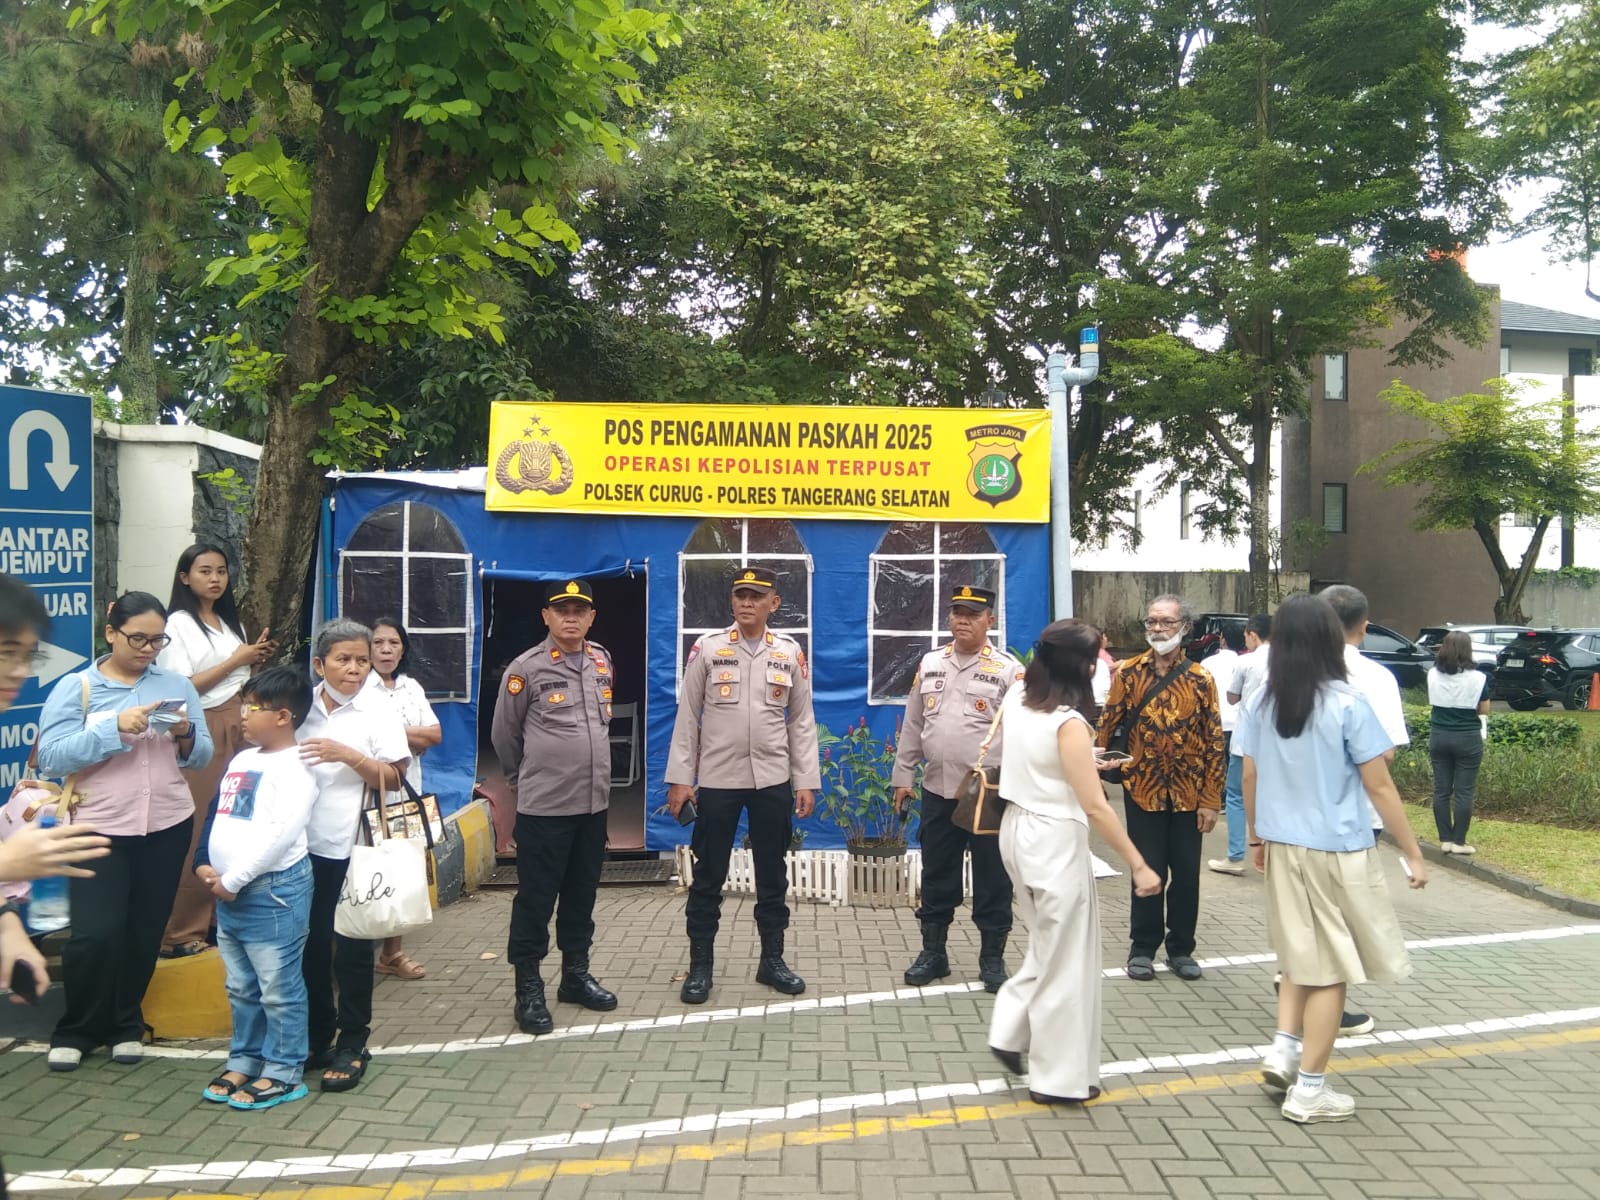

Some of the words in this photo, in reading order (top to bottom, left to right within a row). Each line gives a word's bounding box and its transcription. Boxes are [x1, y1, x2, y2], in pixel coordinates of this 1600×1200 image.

[604, 419, 644, 445] POS
[650, 420, 791, 448] PENGAMANAN
[798, 422, 879, 449] PASKAH
[884, 423, 932, 450] 2025
[970, 427, 999, 438] METRO
[1001, 427, 1021, 439] JAYA
[604, 455, 690, 472] OPERASI
[698, 457, 819, 475] KEPOLISIAN
[826, 459, 931, 477] TERPUSAT
[584, 482, 645, 501] POLSEK
[649, 484, 703, 503] CURUG
[717, 486, 777, 505] POLRES
[781, 487, 876, 507] TANGERANG
[881, 488, 950, 508] SELATAN
[0, 527, 90, 551] ANTAR
[43, 592, 88, 617] UAR
[767, 660, 791, 672] POLRI
[973, 672, 1000, 685] POLRI
